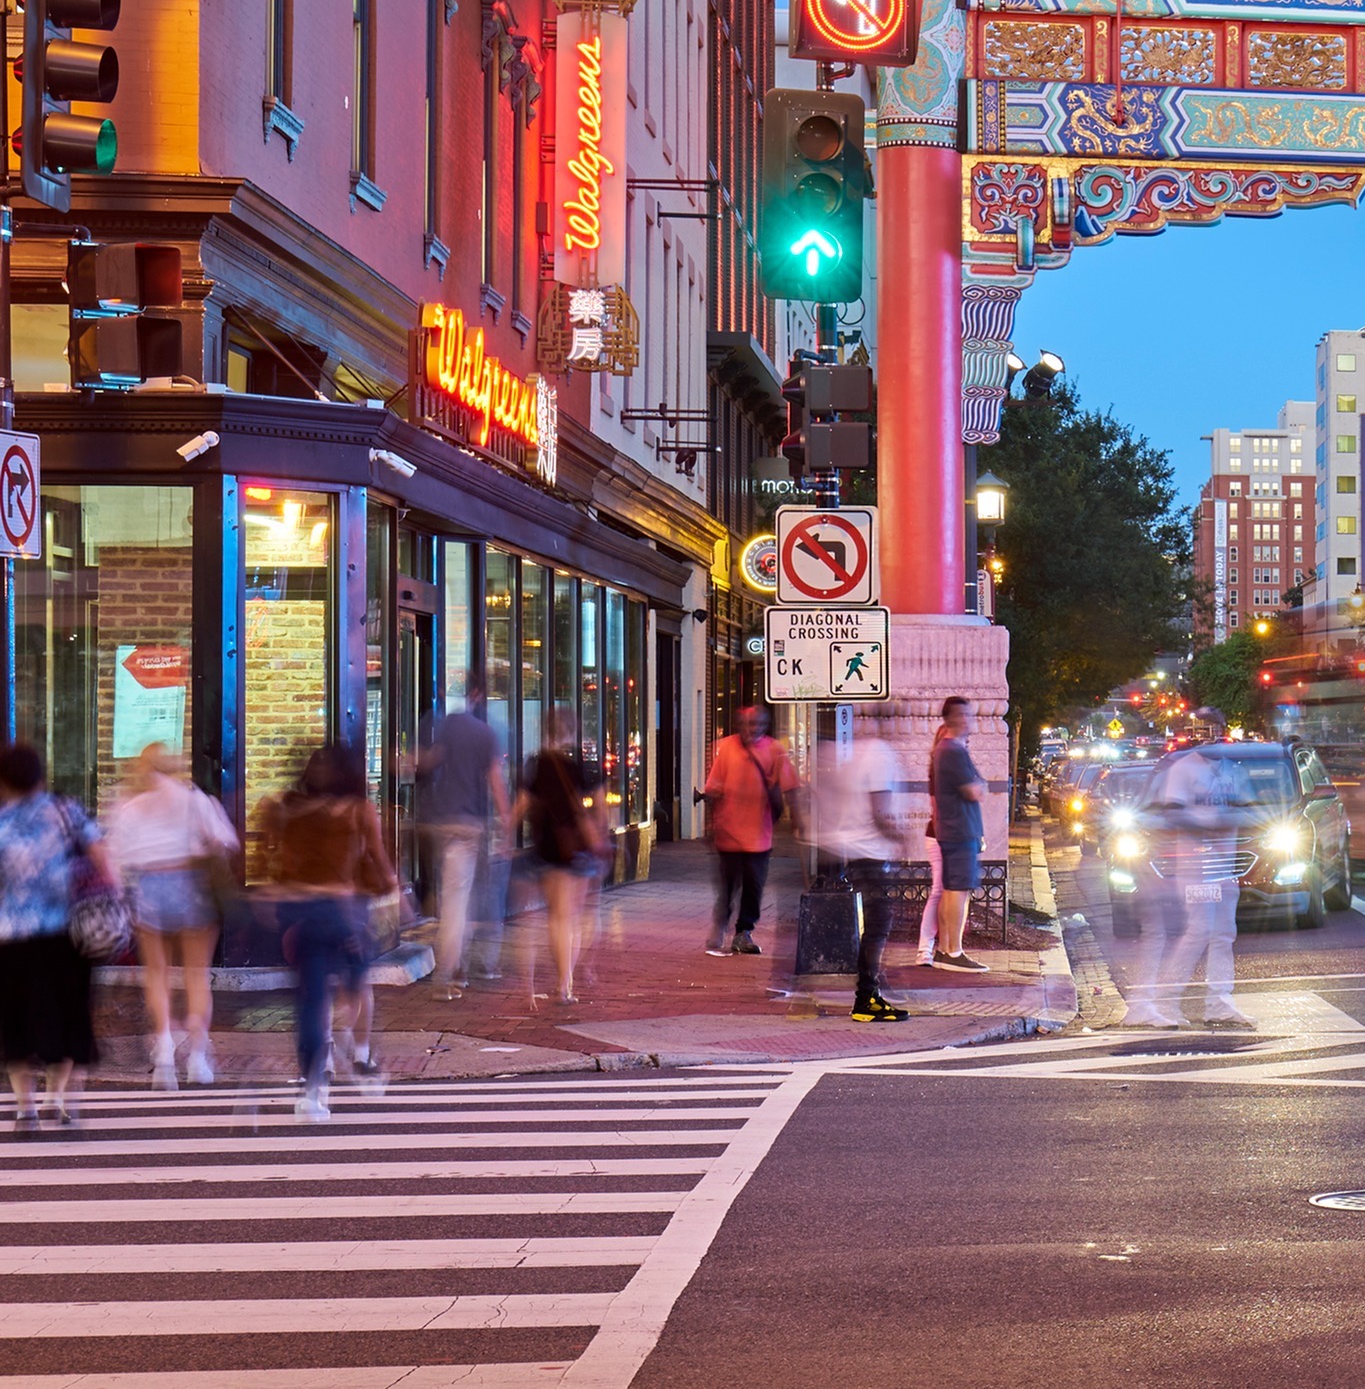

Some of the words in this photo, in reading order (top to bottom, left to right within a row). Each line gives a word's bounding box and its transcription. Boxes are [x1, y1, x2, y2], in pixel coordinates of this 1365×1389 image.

[564, 36, 616, 252] Walgreens
[567, 289, 606, 362] 藥房
[432, 302, 539, 446] Walgreens
[1215, 551, 1224, 582] TODAY
[788, 627, 860, 640] CROSSING
[790, 613, 863, 627] DIAGONAL
